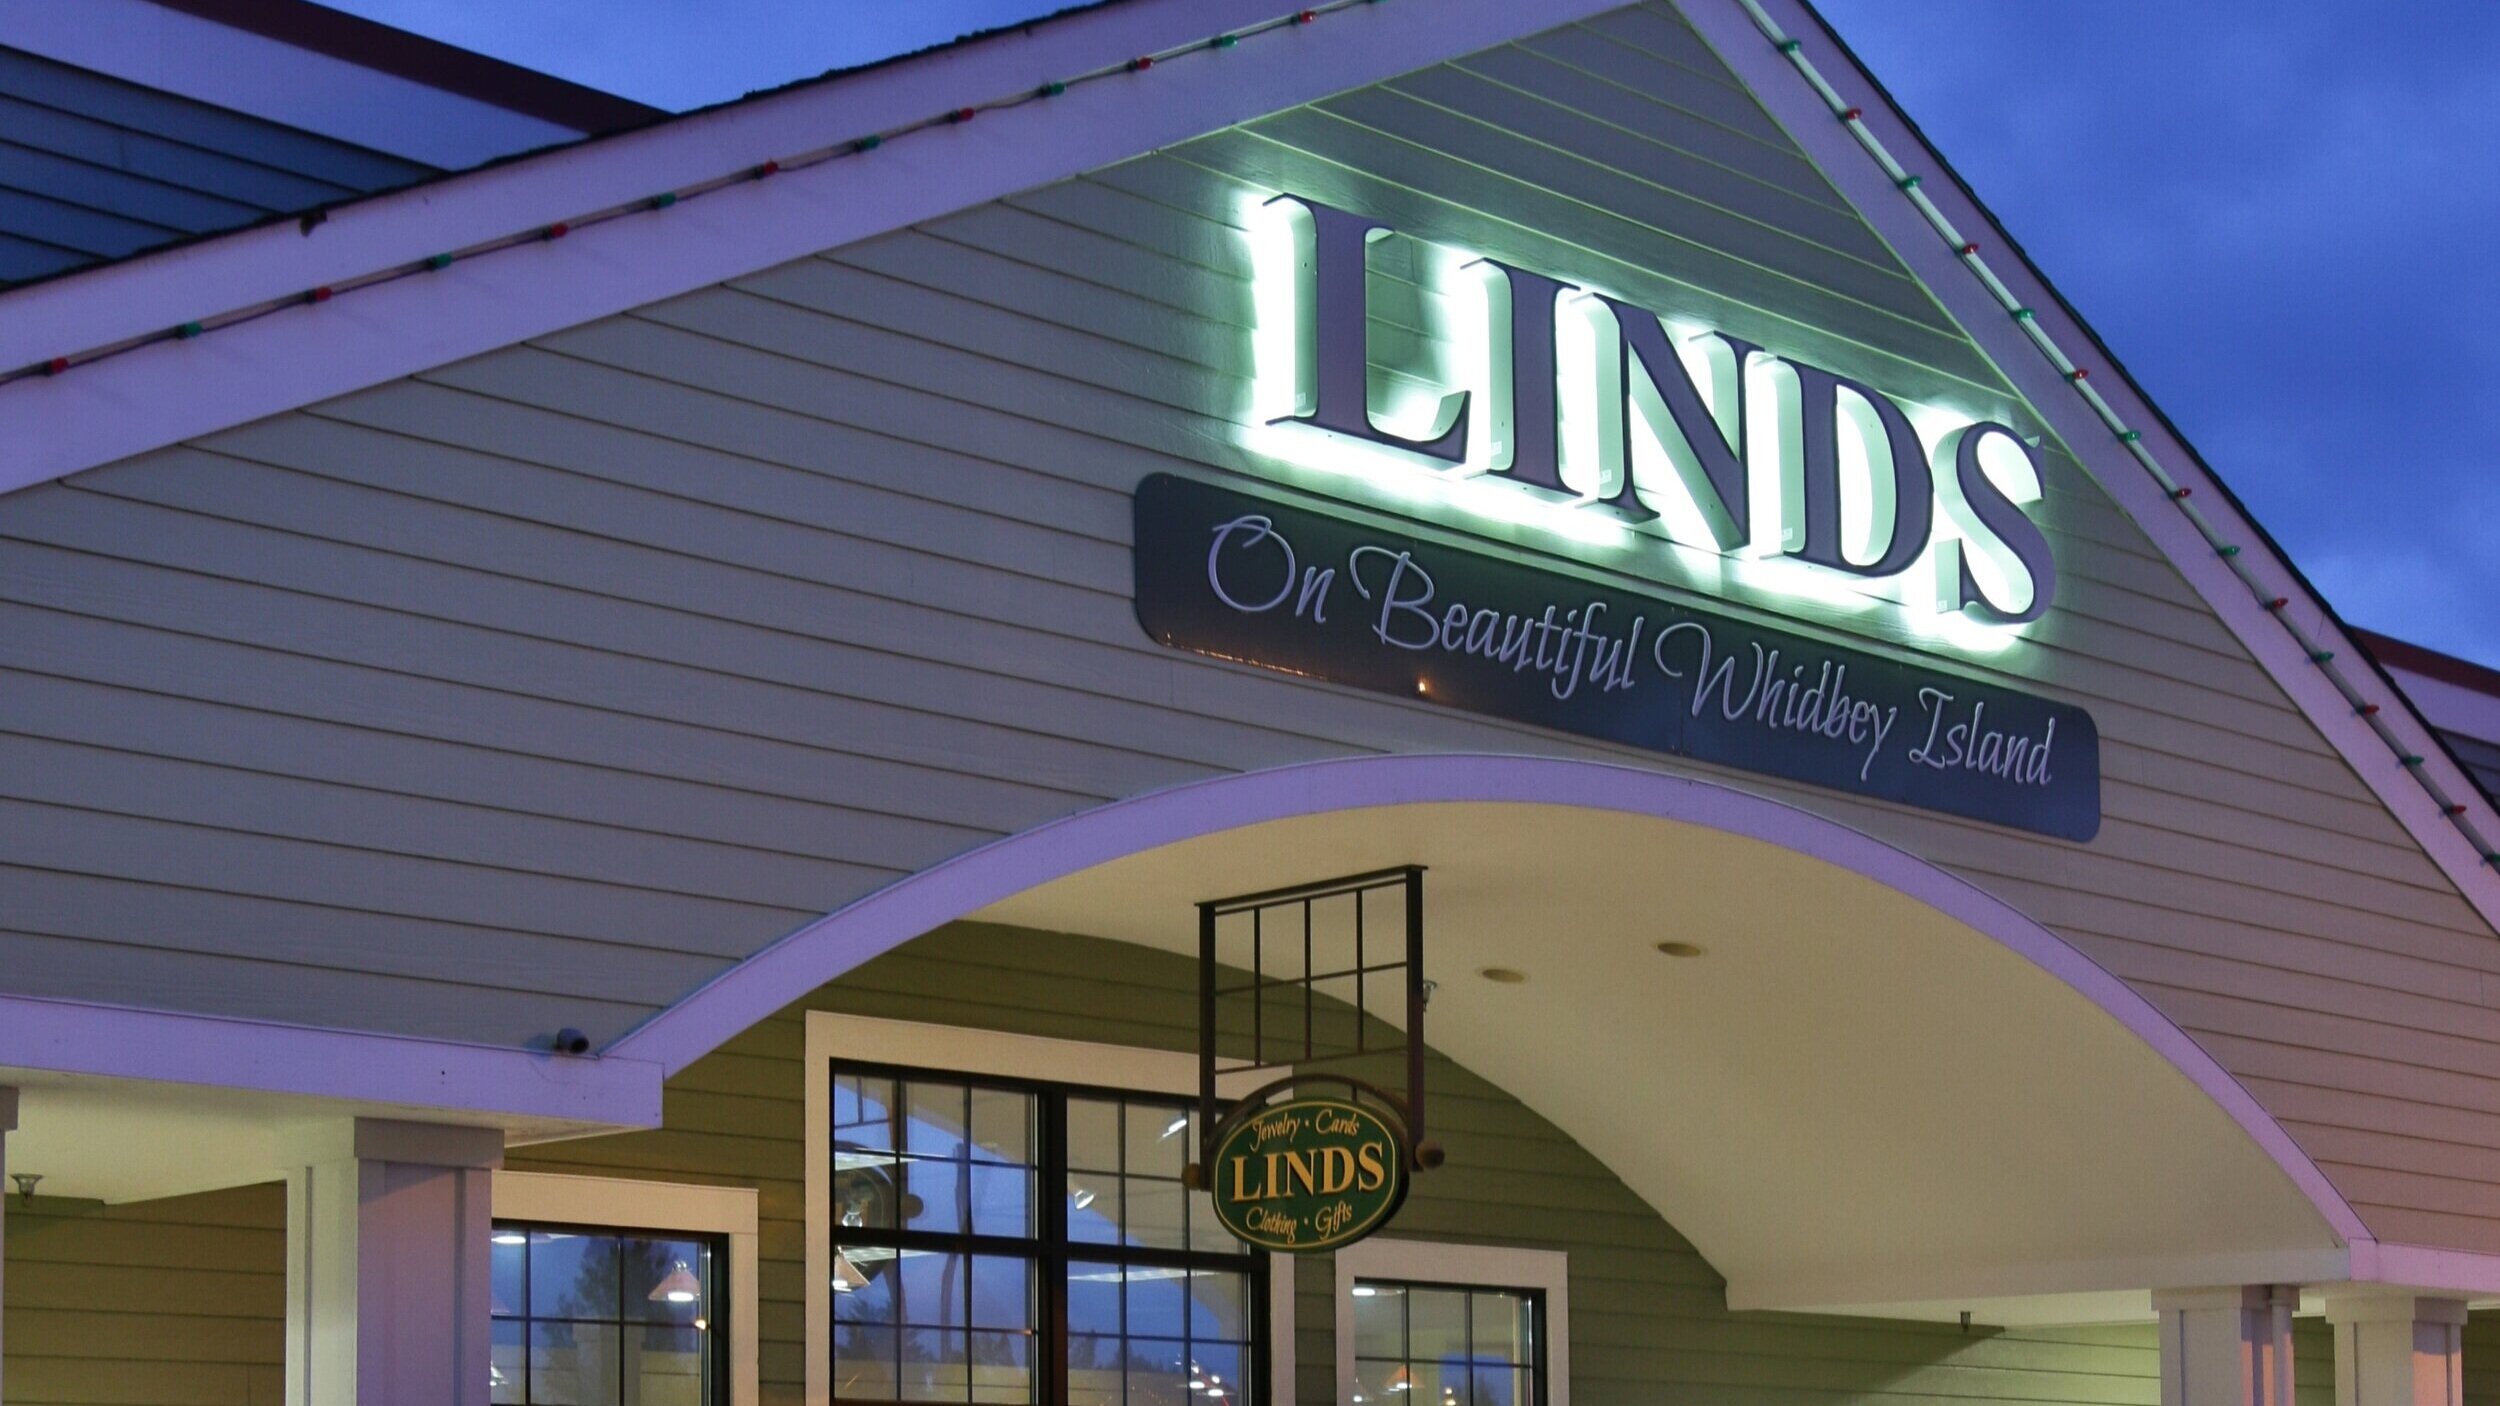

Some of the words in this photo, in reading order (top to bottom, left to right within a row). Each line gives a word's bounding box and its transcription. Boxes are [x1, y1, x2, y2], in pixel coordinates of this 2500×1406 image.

[1262, 193, 2056, 624] LINDS
[1208, 515, 1336, 623] On
[1348, 544, 1645, 700] Beautiful
[1654, 622, 1897, 780] Whidbey
[1908, 687, 2057, 787] Island
[1250, 1113, 1300, 1152] Jewelry
[1315, 1109, 1360, 1137] Cards
[1230, 1141, 1385, 1203] LINDS
[1246, 1206, 1298, 1244] Clothing
[1315, 1200, 1353, 1241] Gifts
